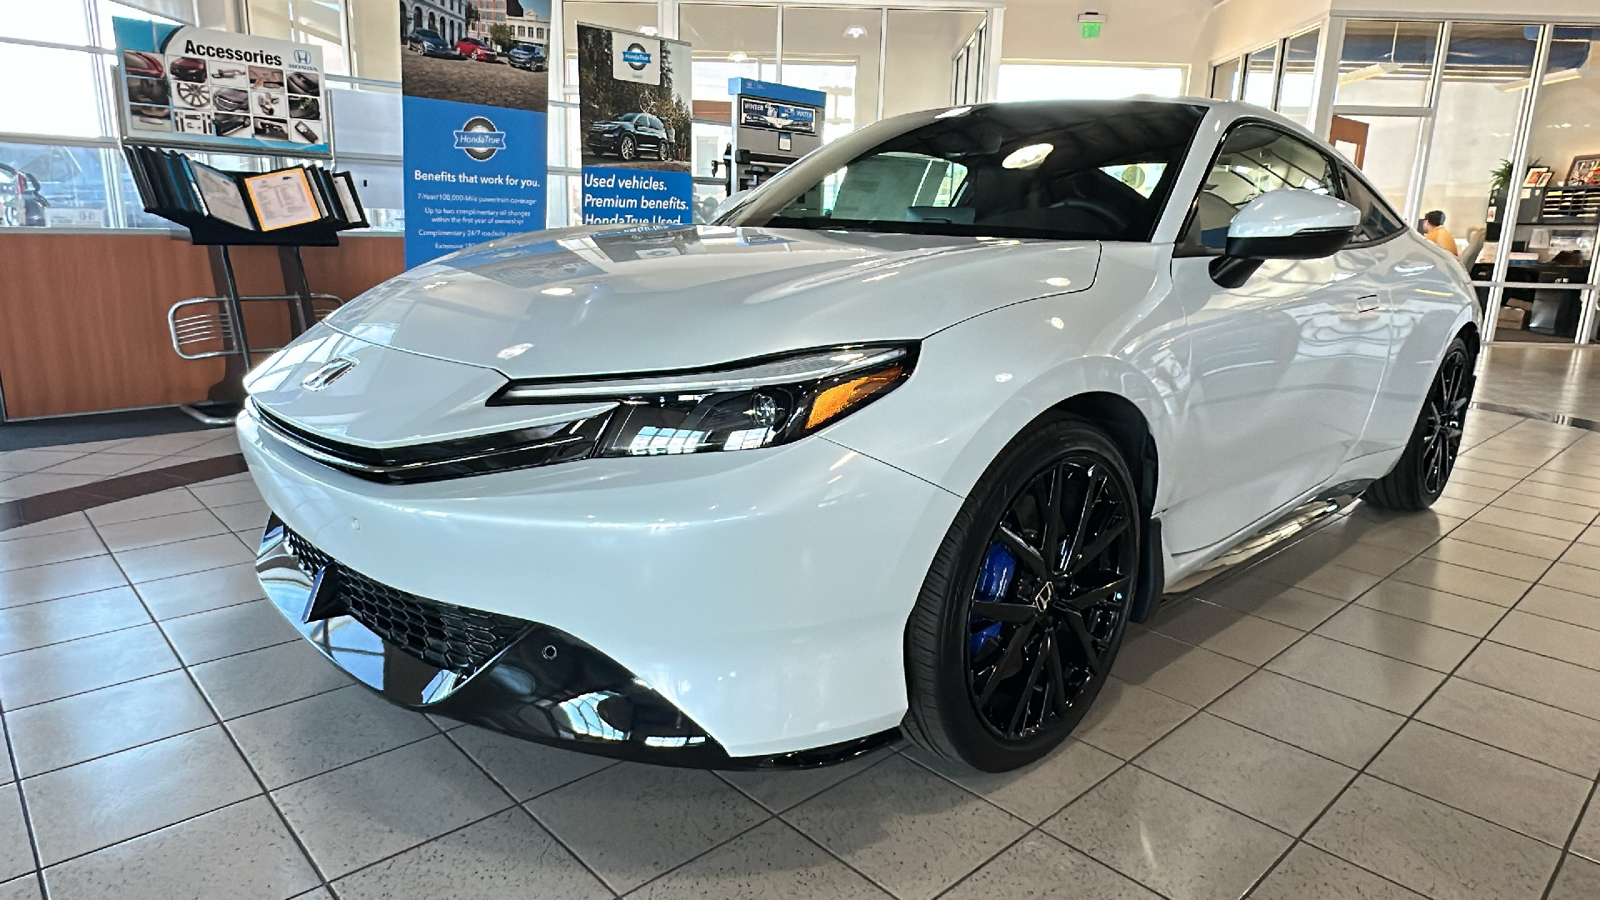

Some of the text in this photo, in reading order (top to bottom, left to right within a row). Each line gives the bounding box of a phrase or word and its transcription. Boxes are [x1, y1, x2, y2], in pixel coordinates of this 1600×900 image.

[185, 39, 283, 66] Accessories
[288, 64, 319, 72] HONDA
[744, 103, 764, 111] WINTER
[460, 134, 501, 144] HondaTrue
[414, 169, 540, 189] Benefits that work for you.
[584, 173, 667, 191] Used vehicles.
[584, 193, 689, 210] Premium benefits.
[424, 207, 435, 215] Up
[455, 209, 499, 217] complimentary
[507, 210, 531, 218] changes
[418, 229, 466, 238] Complimentary
[467, 229, 480, 237] 24/7
[481, 230, 506, 238] roadside
[434, 242, 463, 250] Extensive
